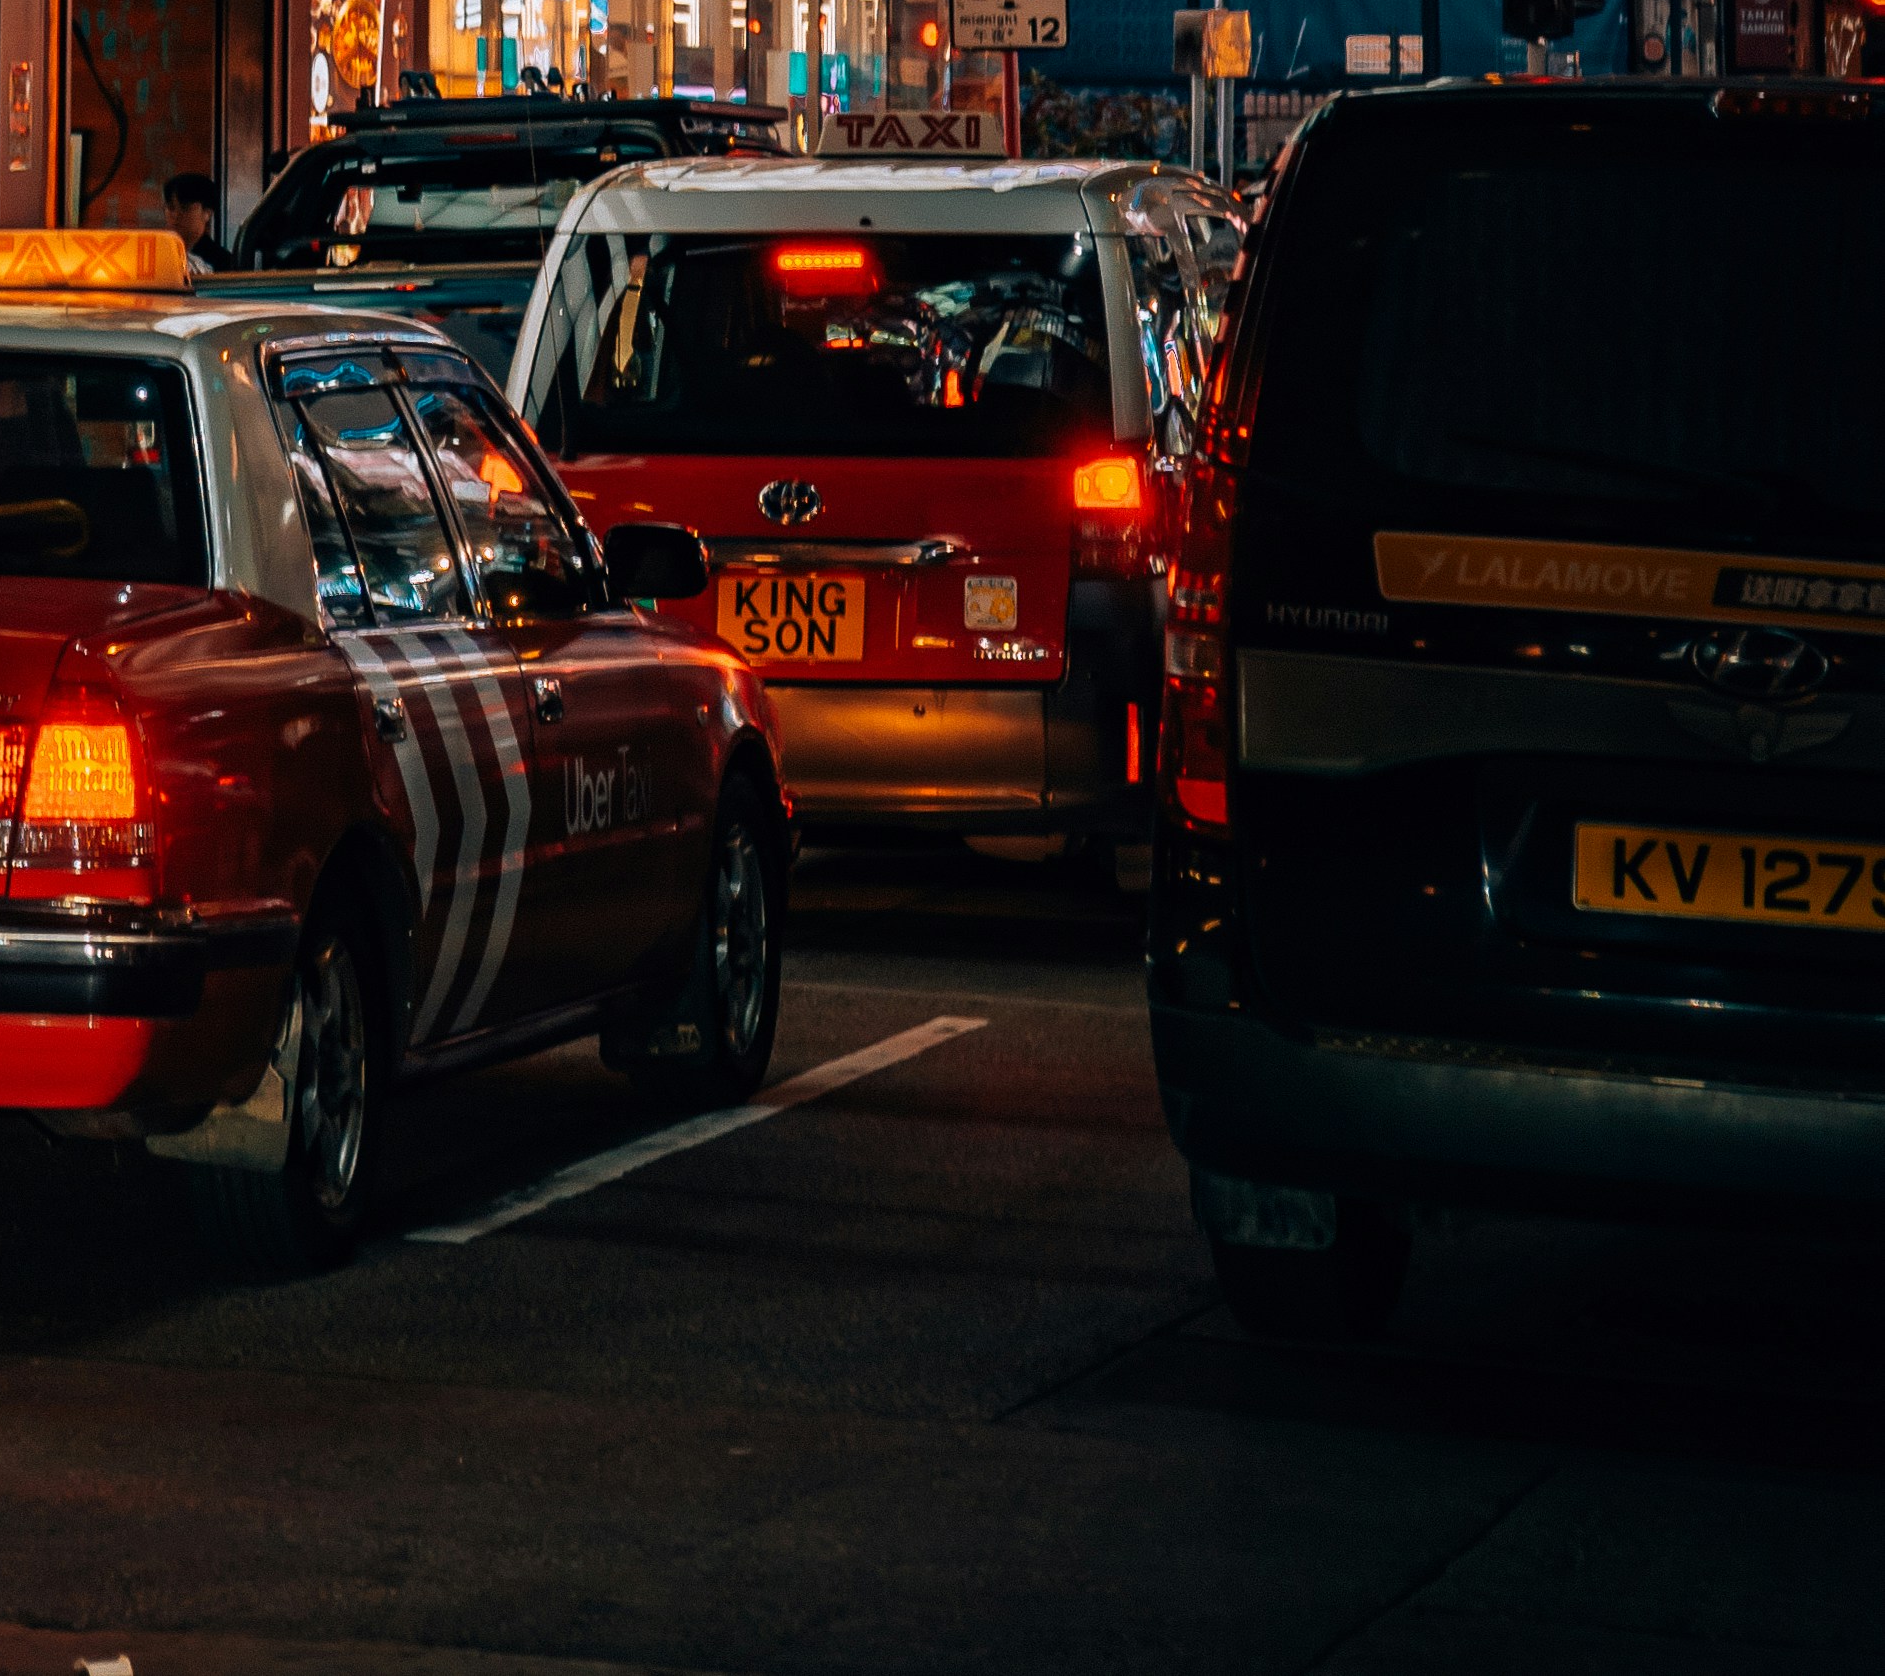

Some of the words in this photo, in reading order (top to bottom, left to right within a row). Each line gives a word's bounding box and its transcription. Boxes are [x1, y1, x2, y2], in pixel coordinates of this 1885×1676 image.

[1027, 17, 1061, 44] 12
[835, 112, 982, 150] TAXI
[1455, 552, 1691, 601] LALAMOVE
[733, 579, 847, 619] KING
[1267, 603, 1389, 634] HYUNDAI
[742, 617, 839, 656] SON
[564, 756, 615, 835] Uber
[1612, 835, 1711, 902] KV
